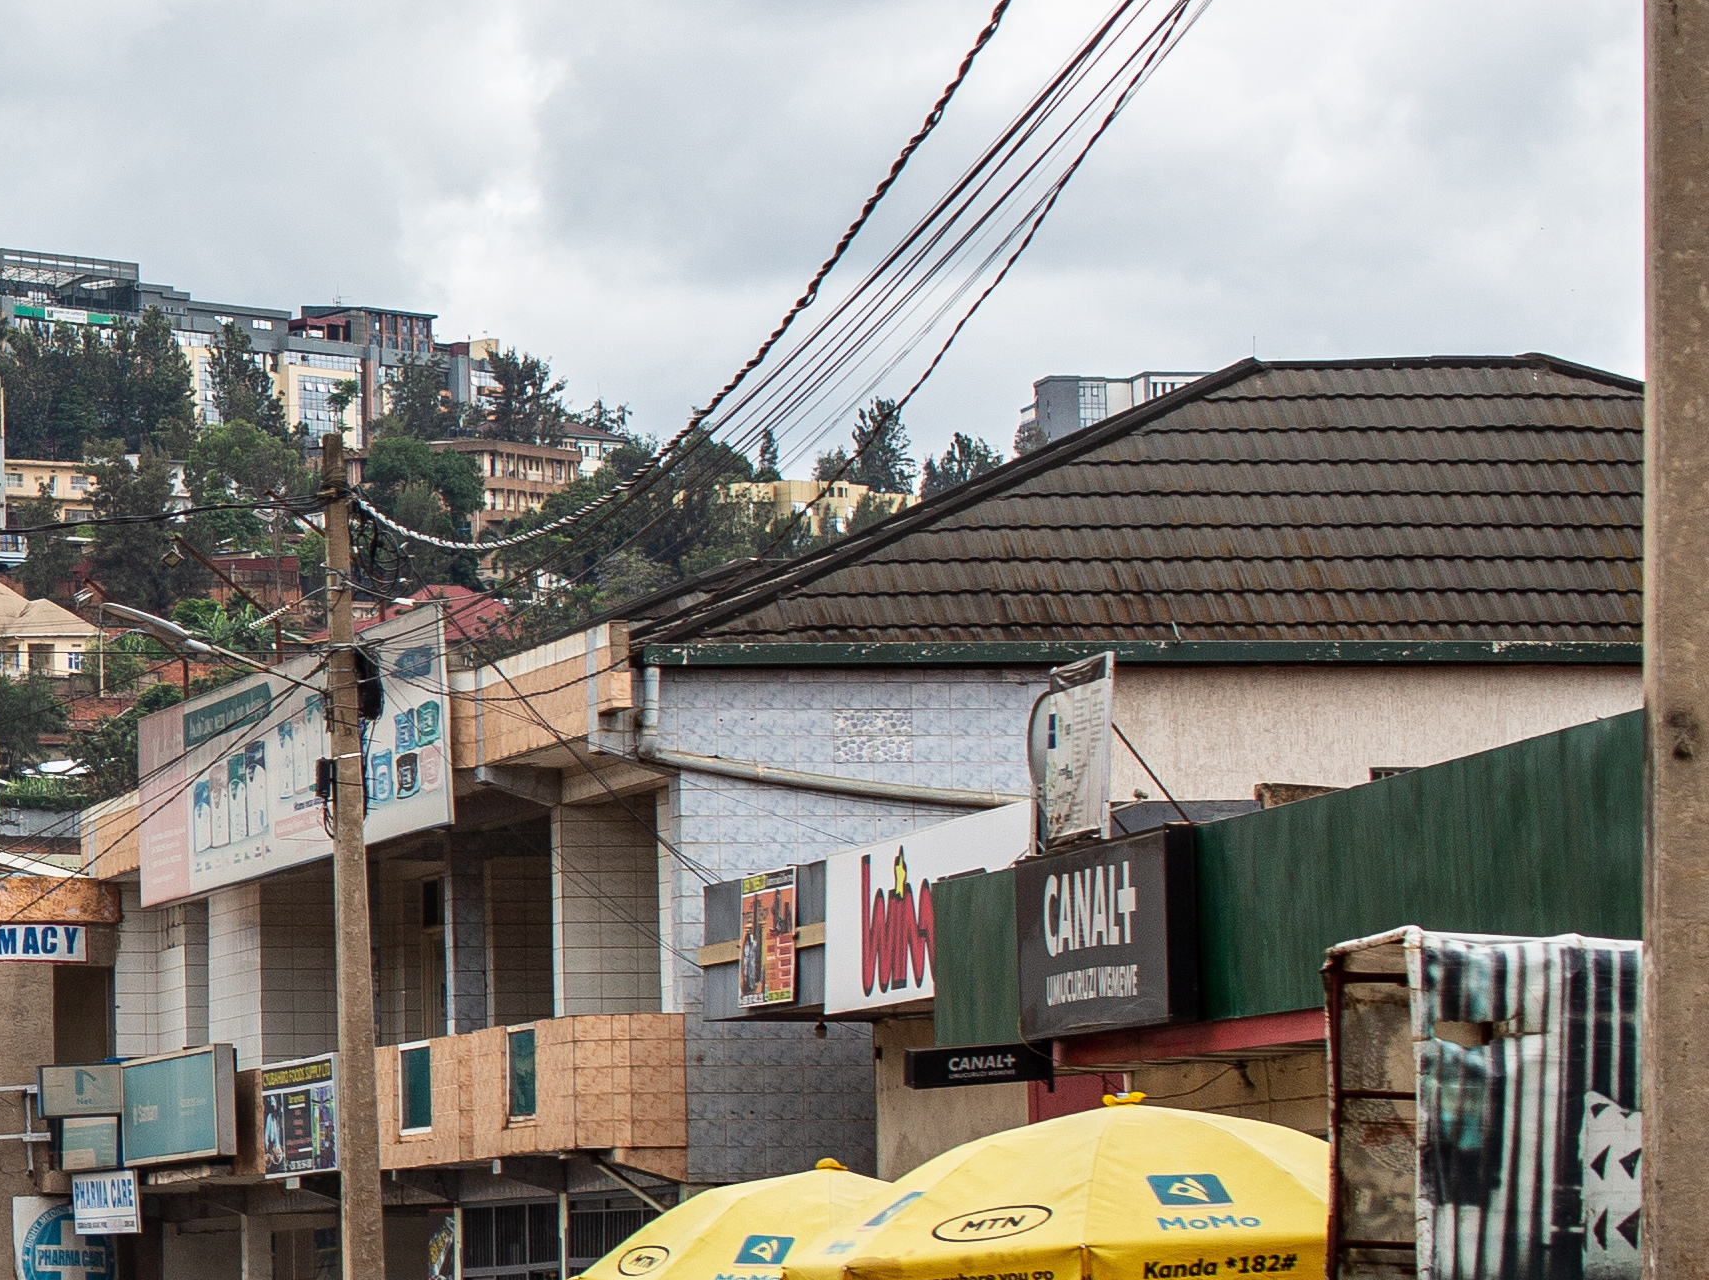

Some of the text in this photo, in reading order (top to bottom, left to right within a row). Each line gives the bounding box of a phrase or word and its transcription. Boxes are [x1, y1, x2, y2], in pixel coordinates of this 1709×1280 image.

[1044, 860, 1138, 958] CANAL+
[948, 1053, 1016, 1071] CANAL+
[73, 1178, 134, 1210] PHARMA CARE
[959, 1214, 1026, 1234] MTN
[1156, 1214, 1262, 1231] MoMo
[37, 1249, 80, 1267] PHARMA
[1142, 1257, 1218, 1280] Kanda
